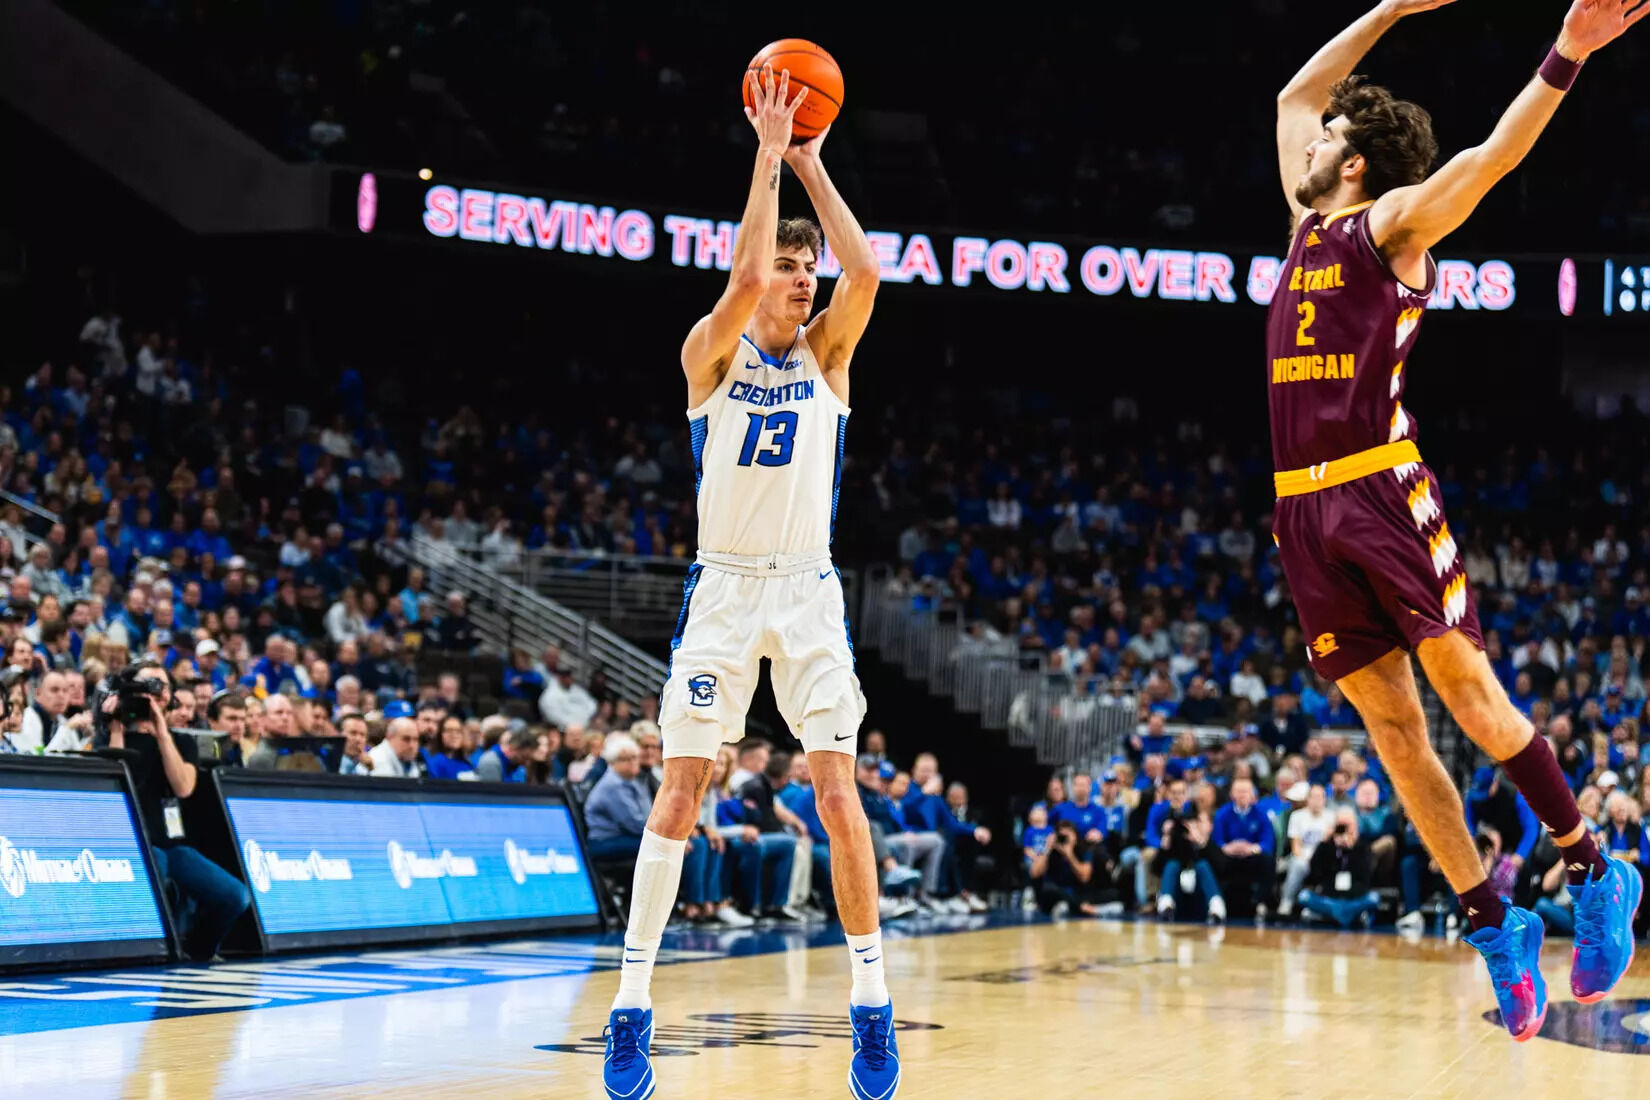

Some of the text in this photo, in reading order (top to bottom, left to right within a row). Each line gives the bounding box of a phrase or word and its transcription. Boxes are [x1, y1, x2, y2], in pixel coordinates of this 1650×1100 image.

[423, 185, 655, 262] SERVING
[664, 214, 743, 272] TH
[952, 236, 1071, 294] FOR
[1080, 244, 1237, 304] OVER
[1247, 255, 1290, 306] 5
[1296, 300, 1316, 346] 2
[1272, 353, 1355, 384] MICHIGAN
[727, 379, 815, 408] CREIHTON
[737, 410, 800, 468] 13
